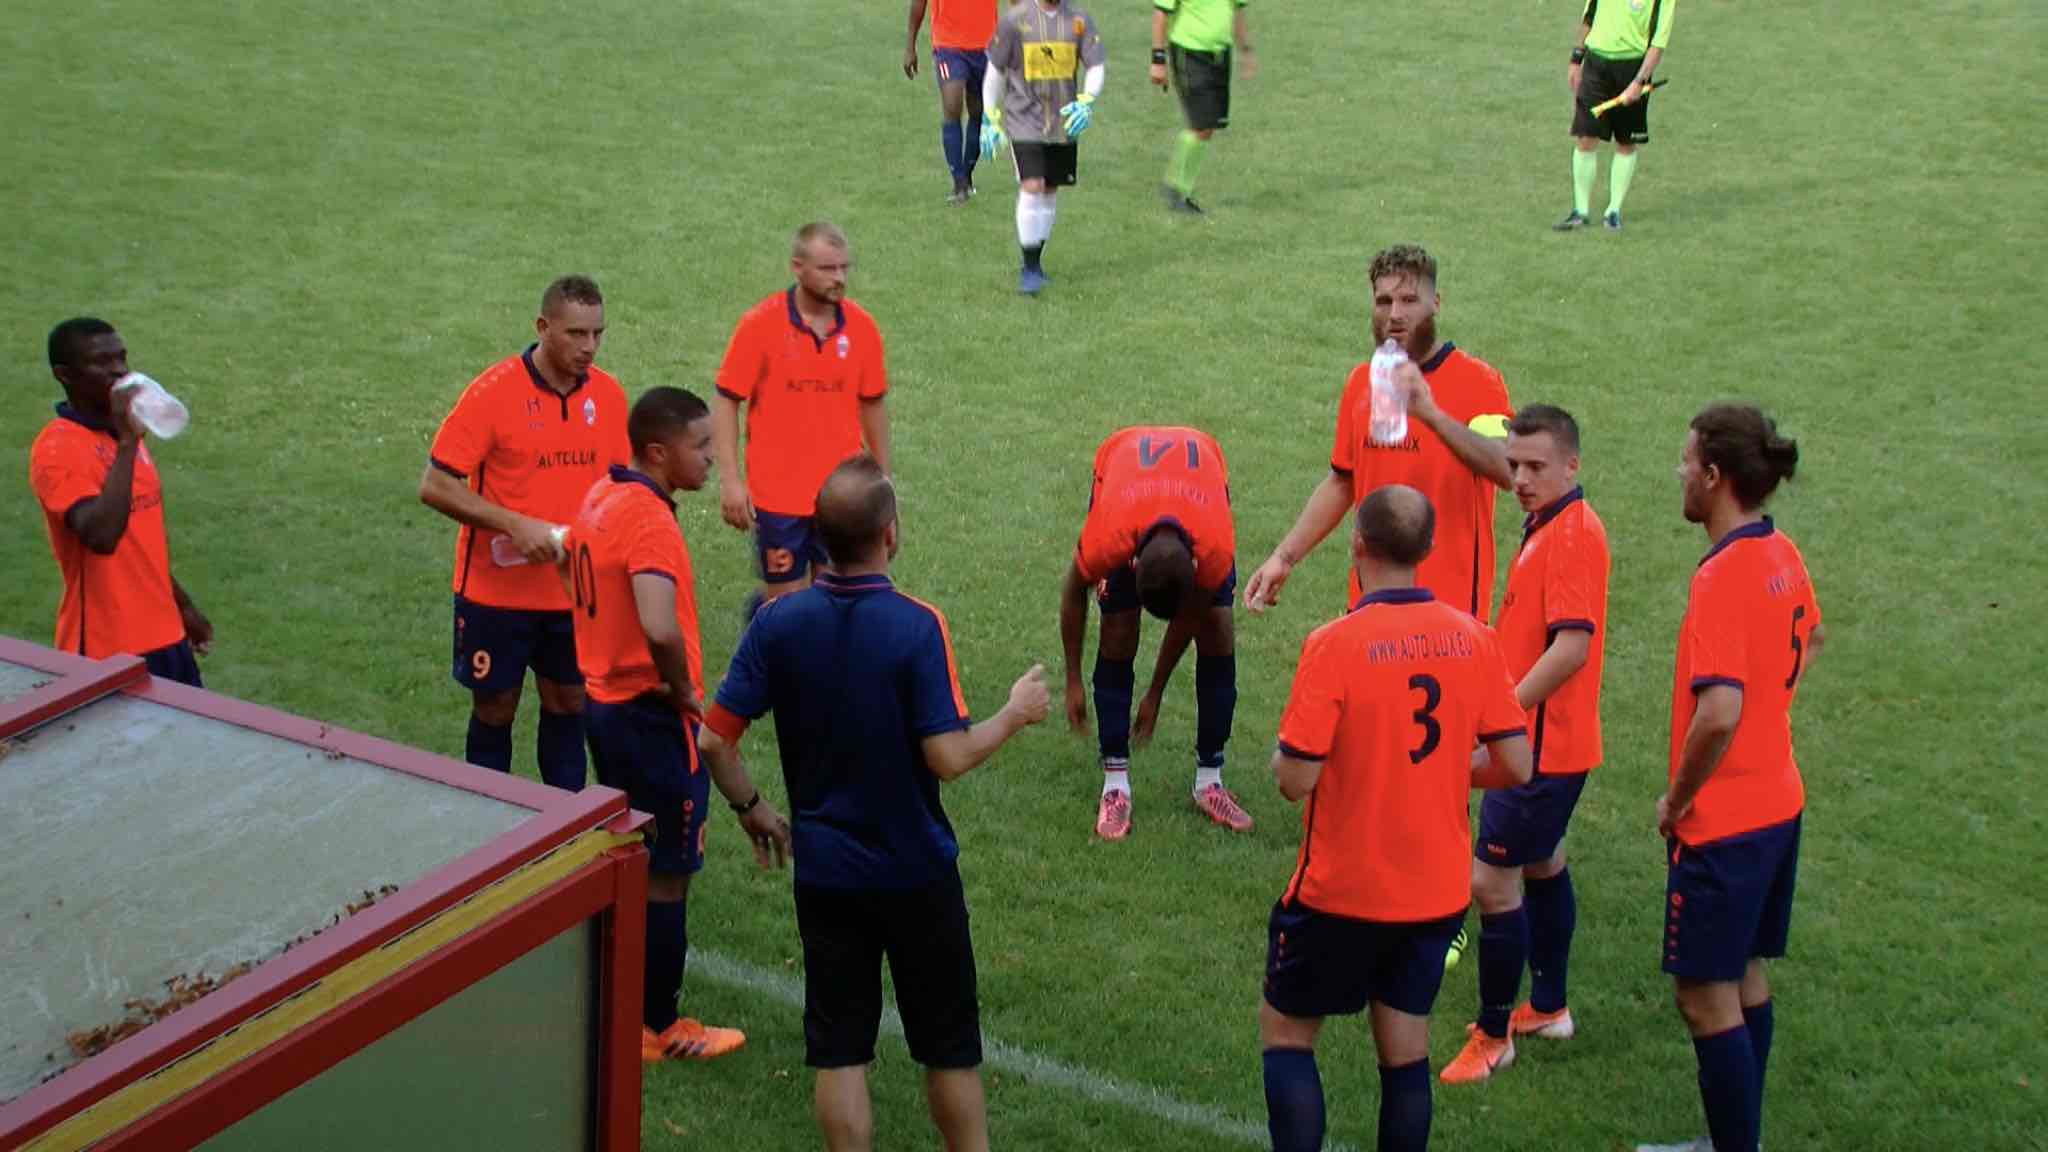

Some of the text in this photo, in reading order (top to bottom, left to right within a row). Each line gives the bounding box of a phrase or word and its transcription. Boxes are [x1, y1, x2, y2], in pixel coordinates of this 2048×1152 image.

[571, 542, 597, 618] 10
[473, 650, 491, 679] 9
[1785, 605, 1804, 689] 5
[1408, 674, 1441, 765] 3
